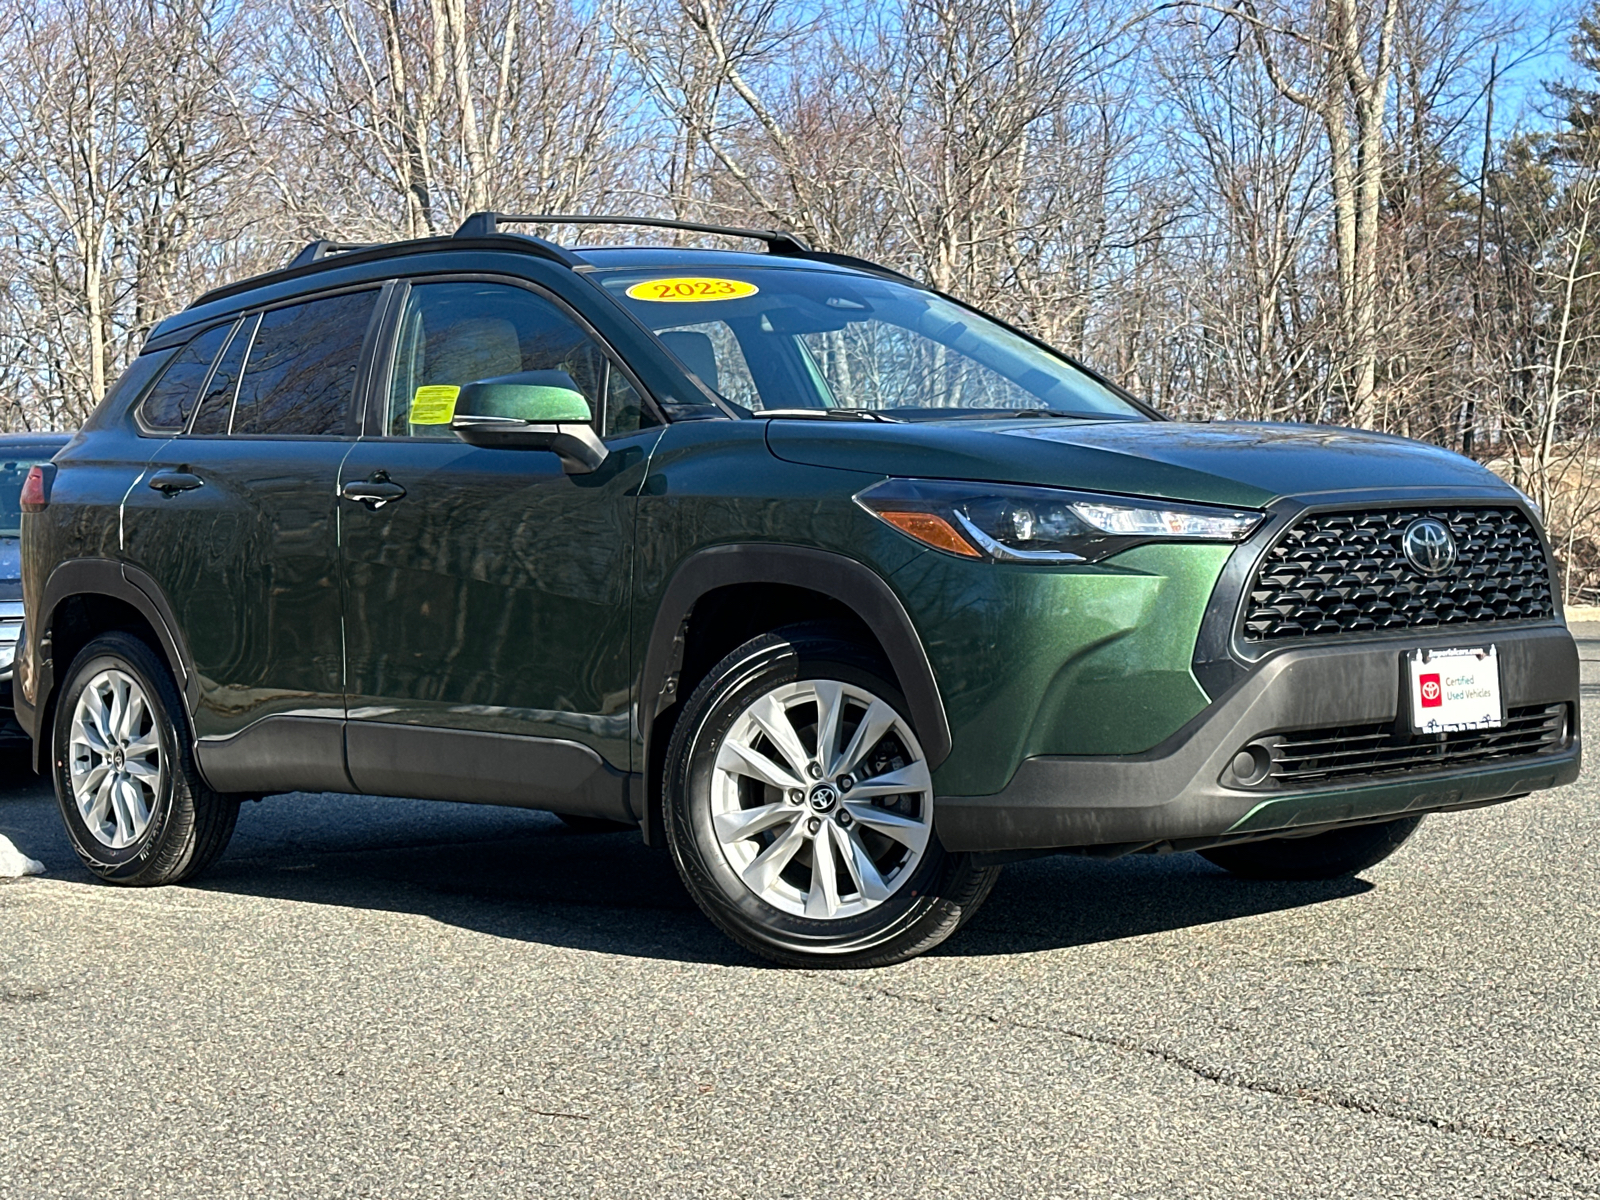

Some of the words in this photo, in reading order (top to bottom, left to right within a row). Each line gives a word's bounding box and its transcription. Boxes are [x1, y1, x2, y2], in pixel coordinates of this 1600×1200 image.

[653, 281, 736, 298] 2023
[1445, 675, 1475, 687] Certified
[1446, 691, 1465, 701] Used
[1465, 688, 1491, 699] Vehicles
